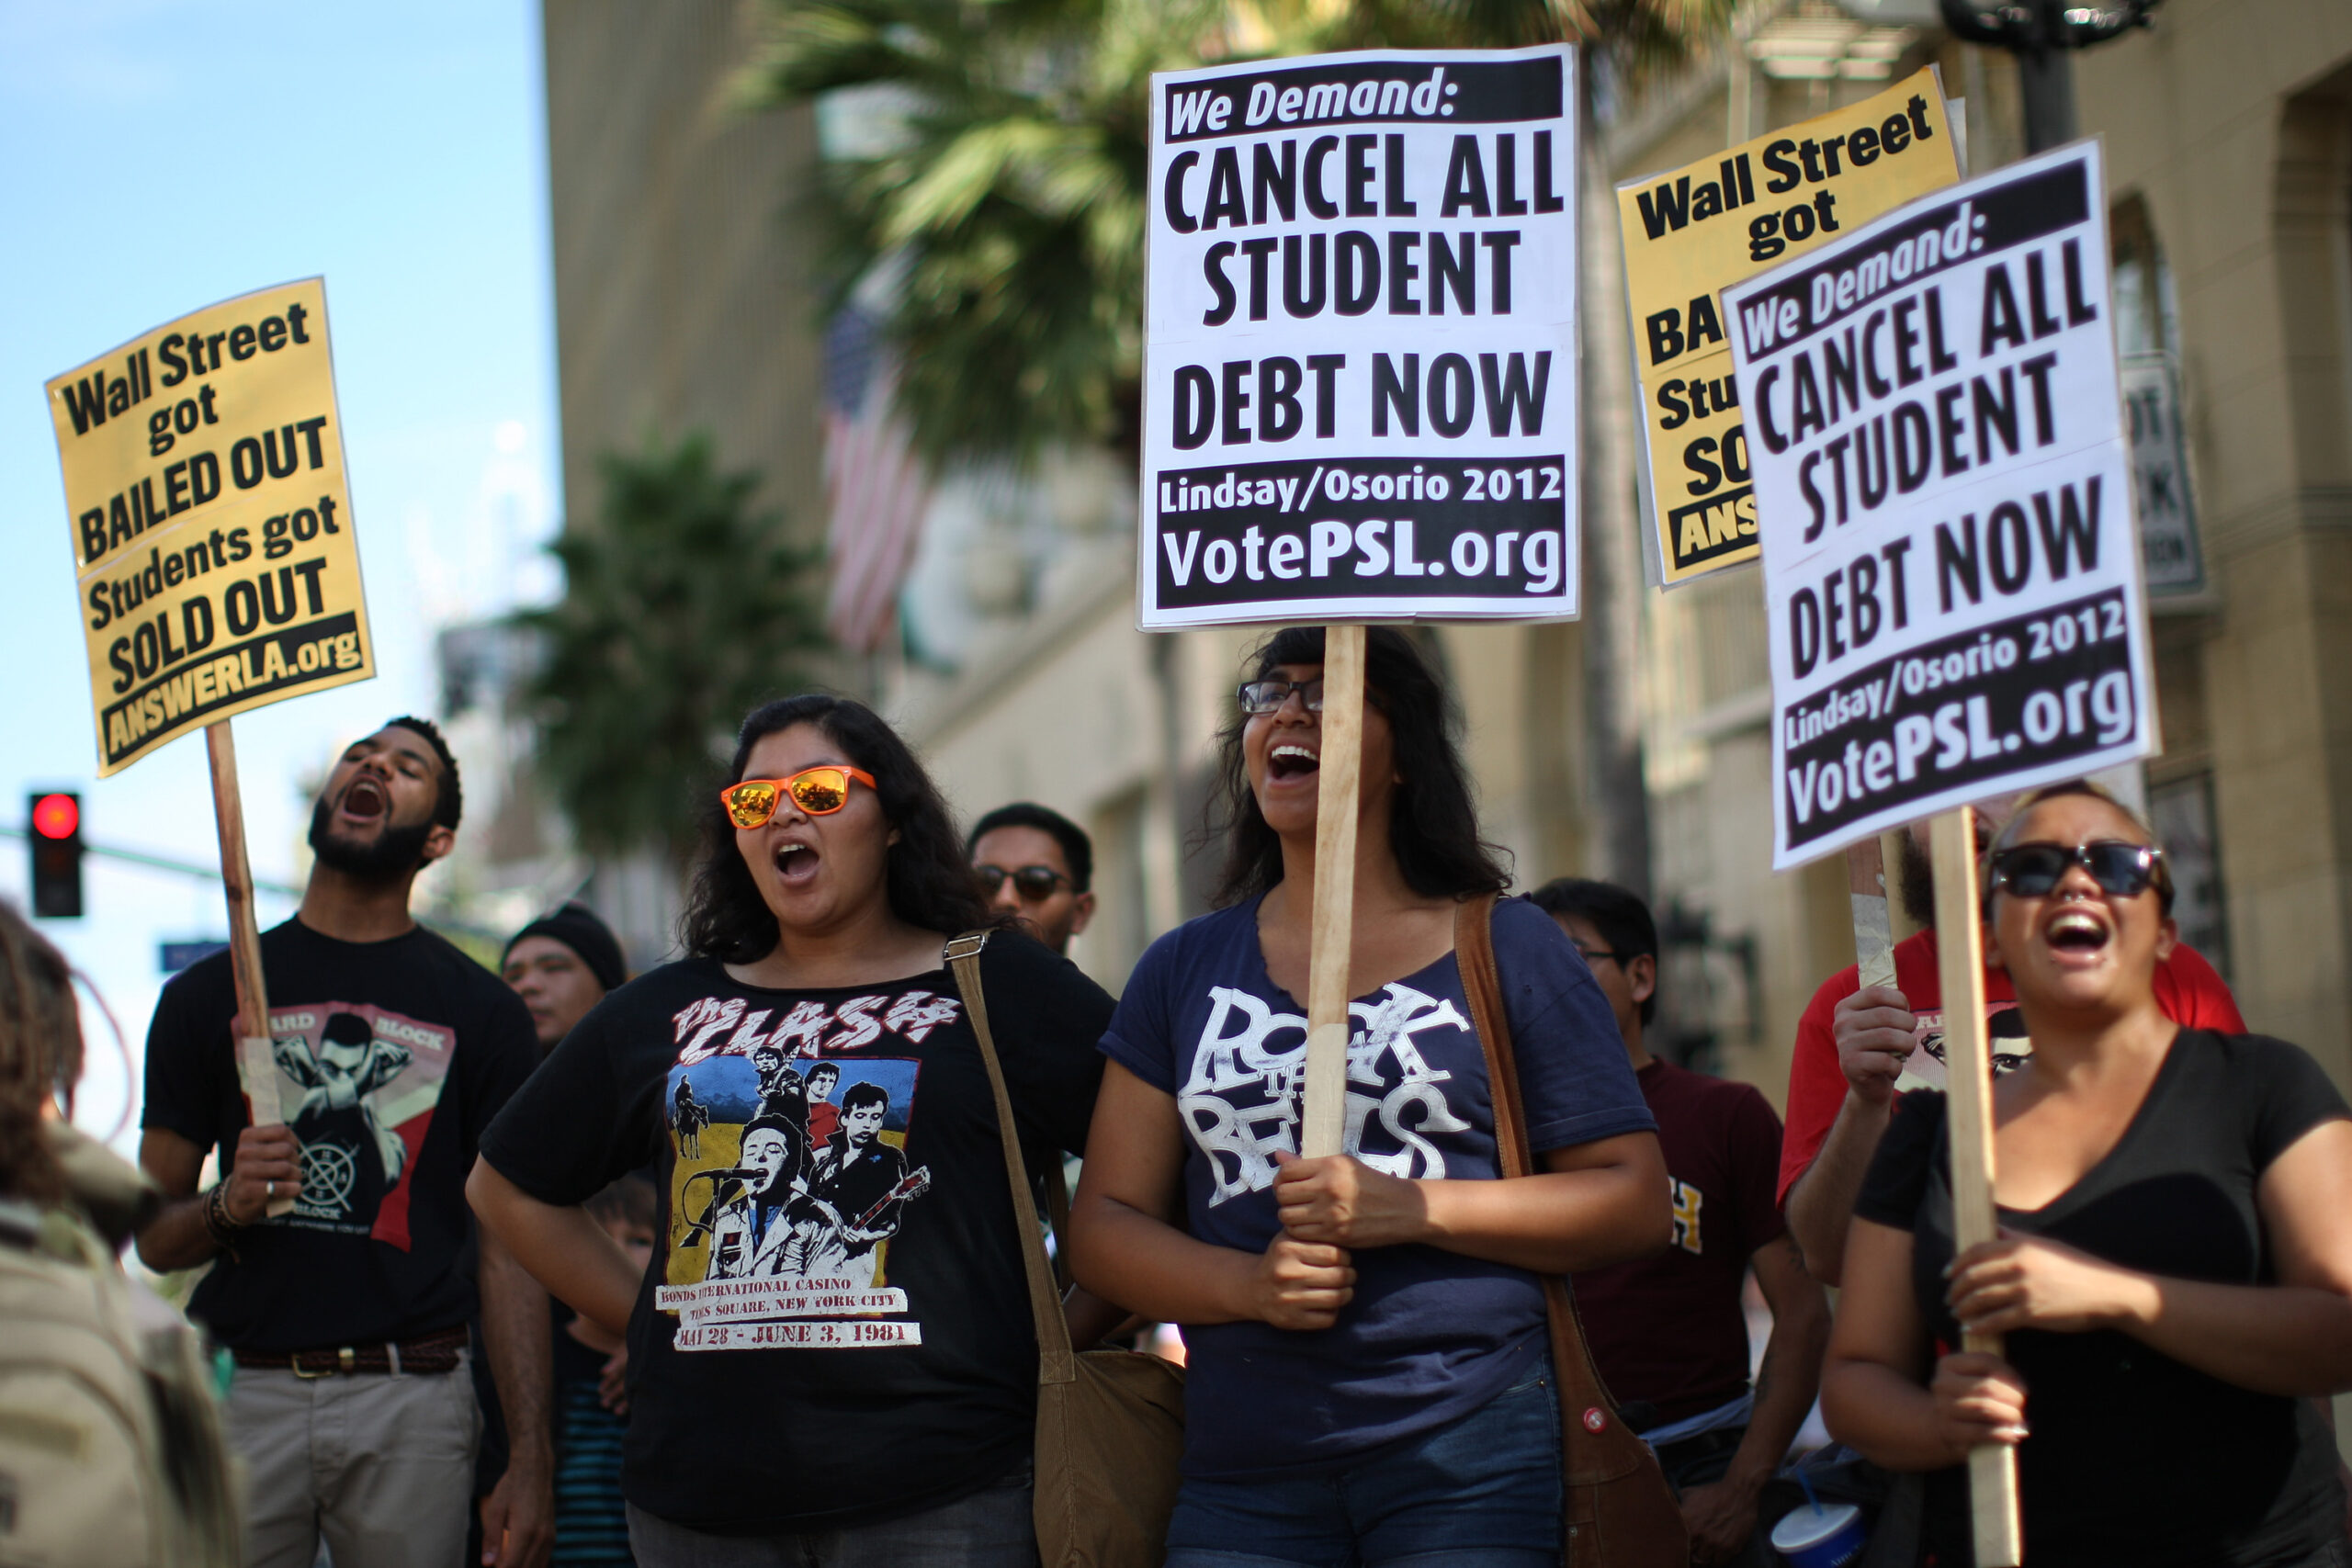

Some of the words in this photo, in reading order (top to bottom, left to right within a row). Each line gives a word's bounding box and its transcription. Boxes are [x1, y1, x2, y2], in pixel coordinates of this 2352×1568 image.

[1170, 90, 1231, 136] We
[1245, 67, 1458, 126] Demand:
[1164, 133, 1416, 233] CANCEL
[1440, 130, 1564, 218] ALL
[1636, 152, 1755, 241] Wall
[1762, 94, 1933, 194] Street
[1749, 189, 1839, 262] got
[1203, 230, 1521, 327] STUDENT
[1745, 295, 1801, 355] We
[1811, 200, 1986, 325] Demand:
[62, 347, 153, 436] Wall
[158, 303, 310, 389] Street
[1646, 294, 1729, 367] BA
[1754, 284, 1958, 455] CANCEL
[1980, 235, 2098, 359] ALL
[149, 384, 218, 457] got
[1172, 354, 1346, 451] DEBT
[1372, 350, 1553, 439] NOW
[1657, 373, 1740, 430] Stu
[1798, 350, 2058, 545] STUDENT
[79, 451, 220, 567] BAILED
[231, 415, 327, 491] OUT
[1161, 465, 1449, 513] Lindsay/Osorio
[1463, 468, 1561, 502] 2012
[1683, 423, 1753, 496] SO
[89, 525, 253, 630] Students
[262, 495, 339, 559] got
[1163, 519, 1560, 592] VotePSL.org
[1679, 493, 1759, 558] ANS
[108, 596, 214, 694] SOLD
[224, 556, 327, 636] OUT
[1789, 535, 1912, 681] DEBT
[1934, 473, 2103, 615] NOW
[108, 629, 360, 754] ANSWERLA.org
[1786, 633, 2018, 750] Lindsay/Osorio
[2027, 600, 2125, 660] 2012
[1788, 671, 2133, 824] VotePSL.org
[270, 1012, 317, 1032] ARD
[374, 1016, 446, 1051] BLOCK
[1260, 1064, 1306, 1098] TH
[1178, 1083, 1471, 1209] BELS
[661, 1288, 696, 1303] BONDS
[795, 1278, 852, 1291] CASINO
[707, 1327, 729, 1345] 28
[752, 1325, 811, 1343] JUNE
[820, 1325, 842, 1344] 3,
[853, 1324, 906, 1341] 1981
[716, 1300, 770, 1315] SQUARE,
[775, 1297, 808, 1310] NEW
[815, 1295, 855, 1308] YORK
[861, 1293, 897, 1306] CITY
